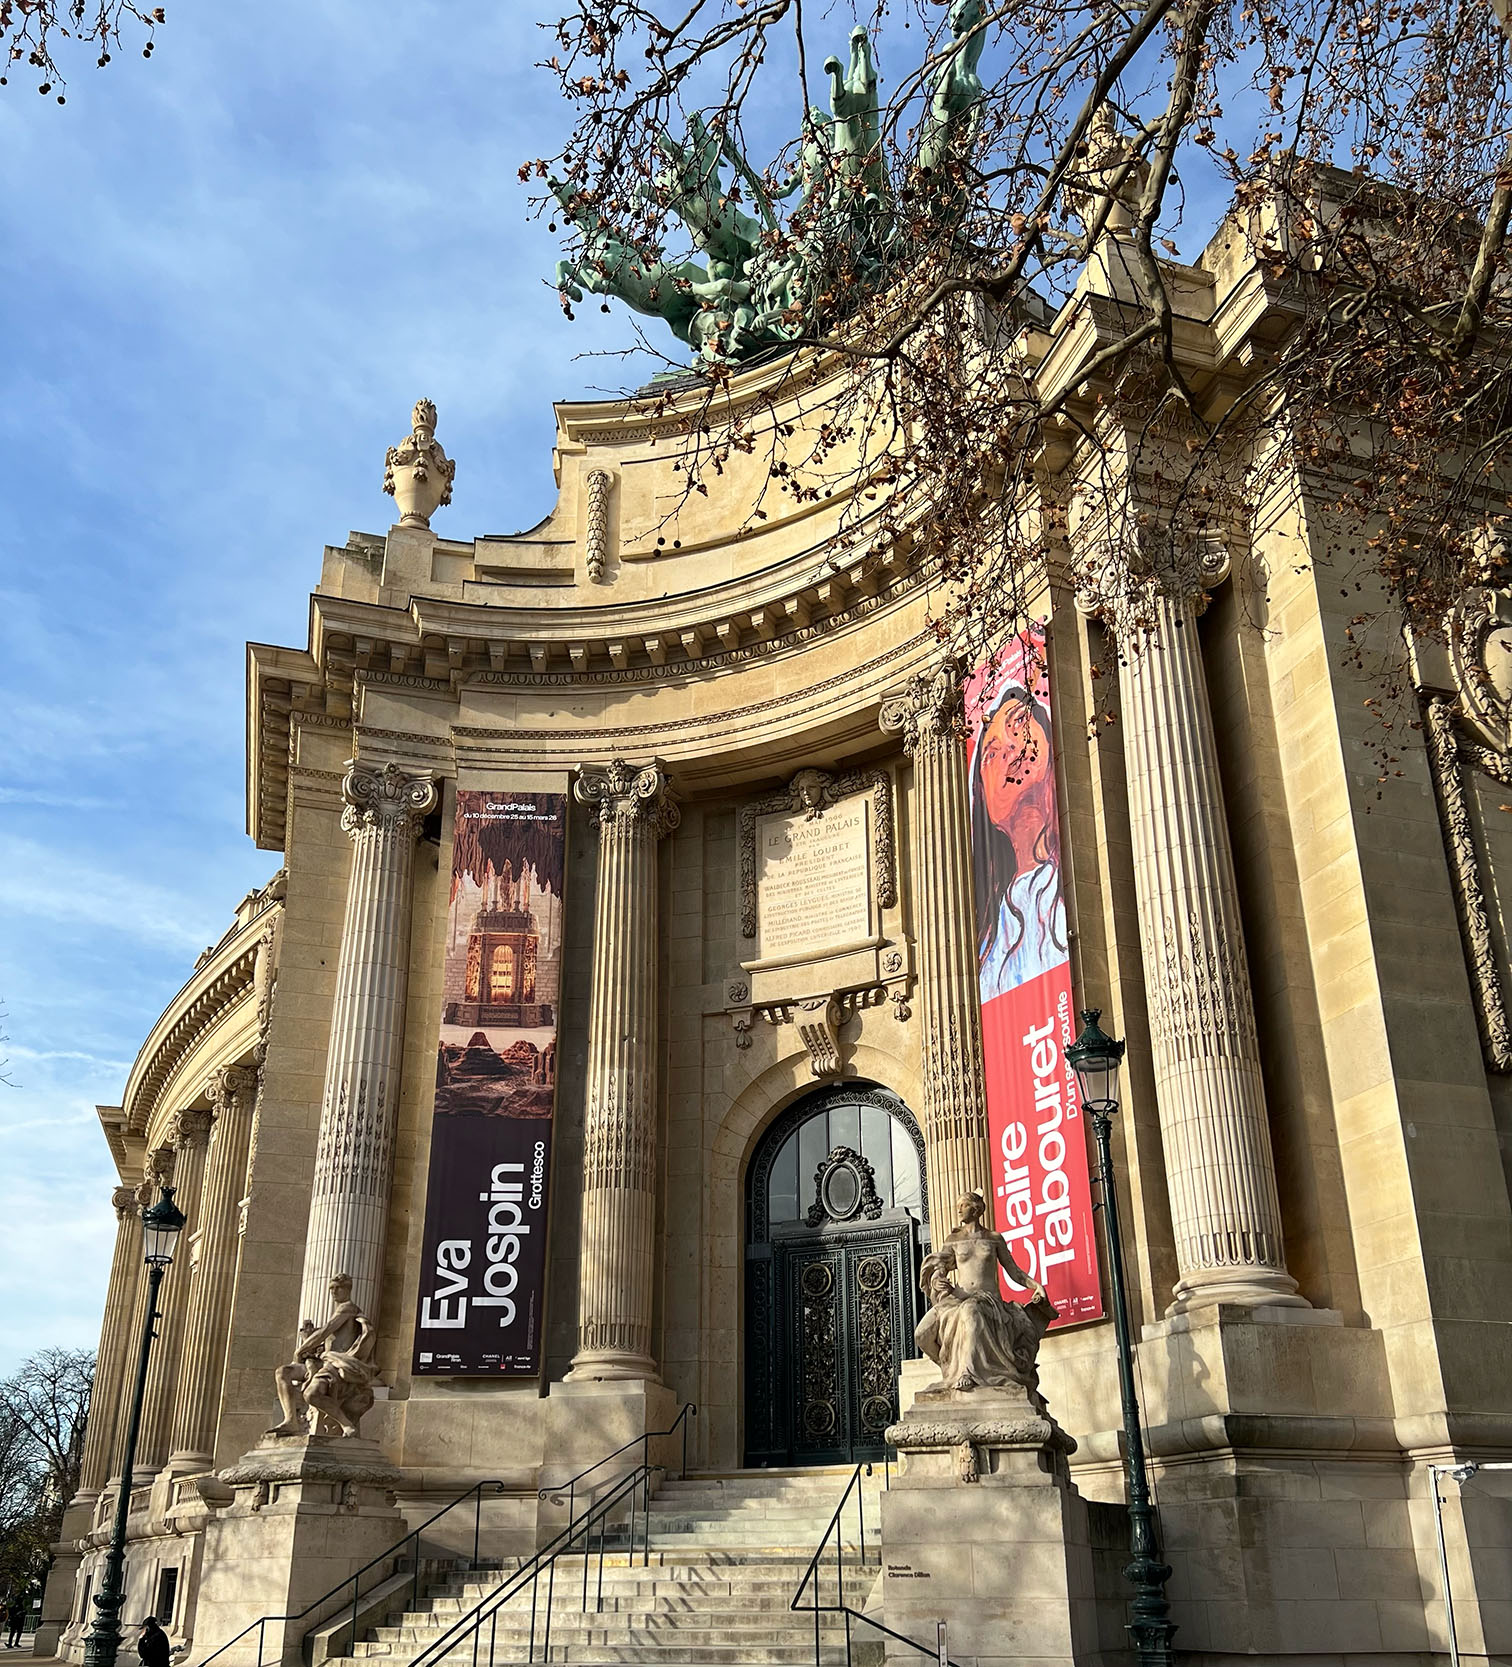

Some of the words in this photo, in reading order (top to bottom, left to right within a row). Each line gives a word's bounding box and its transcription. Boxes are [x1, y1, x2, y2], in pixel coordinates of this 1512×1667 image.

[486, 802, 536, 811] GrandPalais
[768, 836, 779, 846] LE
[784, 826, 820, 843] GRAND
[825, 816, 859, 833] PALAIS
[813, 841, 849, 856] LOUBET
[1057, 991, 1071, 1047] souffle
[1065, 1081, 1078, 1120] D'un
[528, 1141, 545, 1210] Grottesco
[1022, 1016, 1075, 1286] Tabouret
[472, 1163, 530, 1328] Jospin
[421, 1240, 471, 1329] Eva
